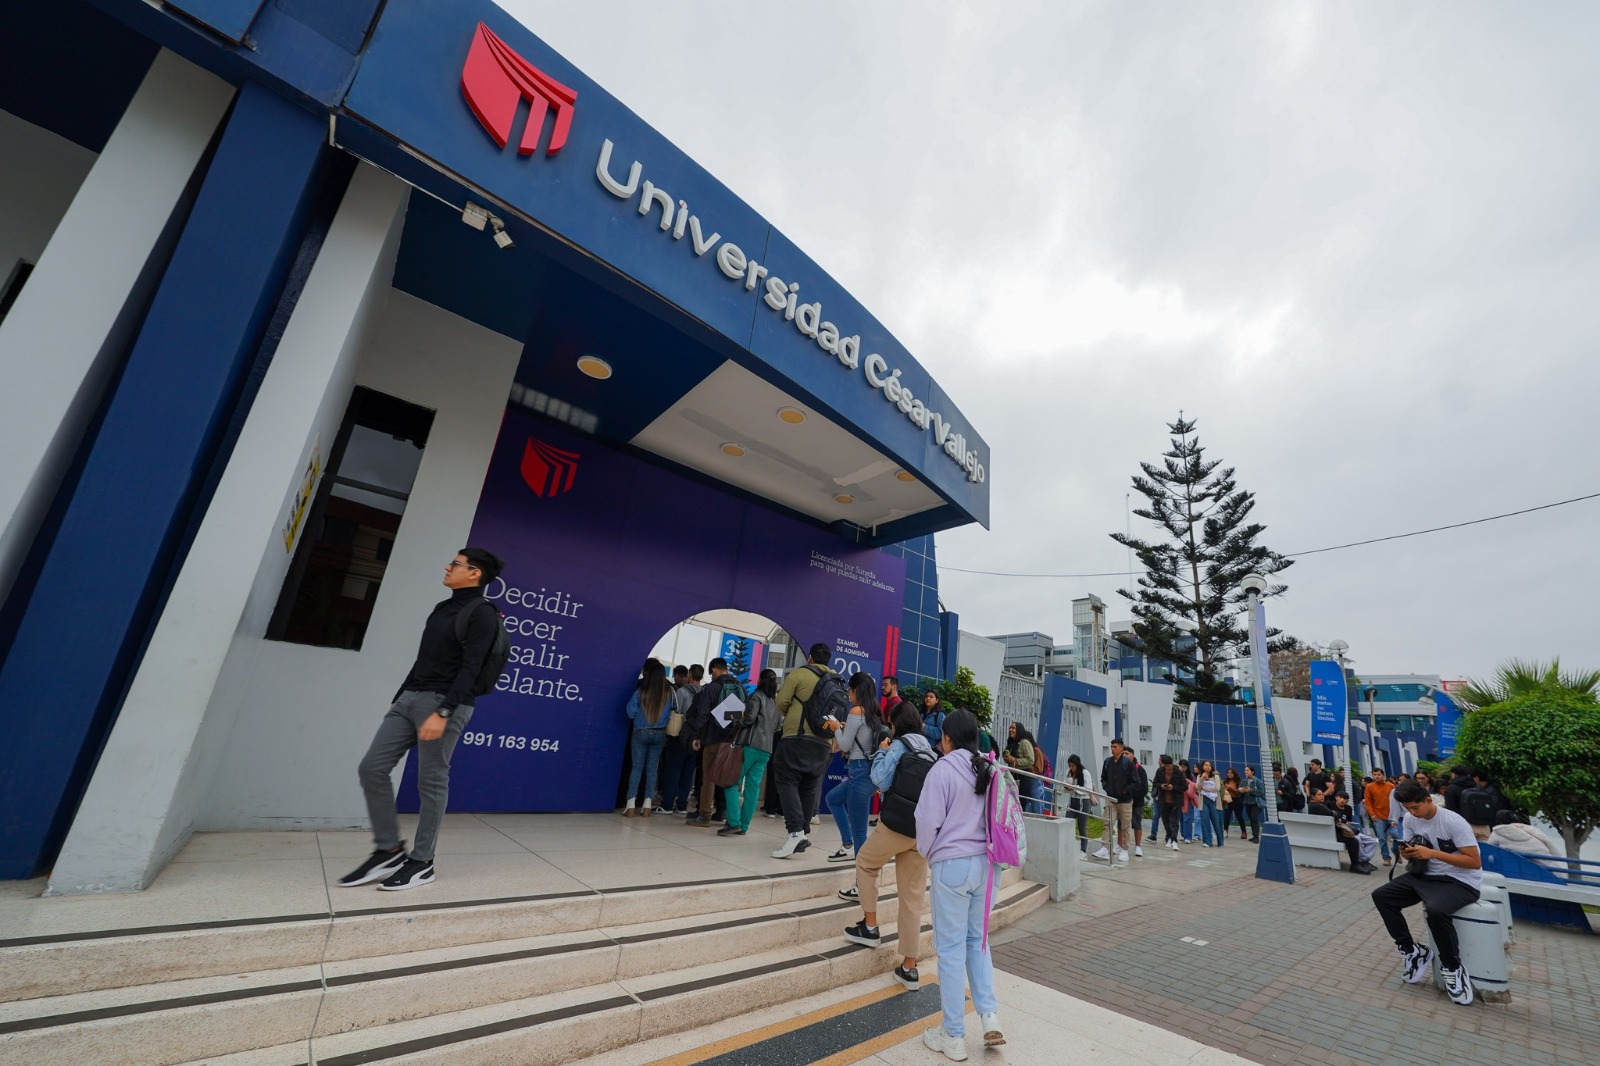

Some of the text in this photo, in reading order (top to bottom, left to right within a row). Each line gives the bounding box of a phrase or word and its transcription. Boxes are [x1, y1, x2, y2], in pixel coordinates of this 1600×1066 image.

[596, 138, 985, 483] Universidad César Vallejo
[810, 559, 824, 569] para
[826, 565, 837, 574] que
[838, 568, 858, 580] puedas
[859, 575, 872, 585] salir
[811, 550, 876, 579] Licenciada por Sunedu
[483, 576, 583, 619] Decidir
[501, 614, 562, 641] ecer
[836, 637, 859, 648] EXAMEN
[844, 648, 870, 659] ADMISIÓN
[507, 644, 569, 671] salir
[495, 668, 583, 702] elante.
[463, 731, 559, 752] 991 163 954
